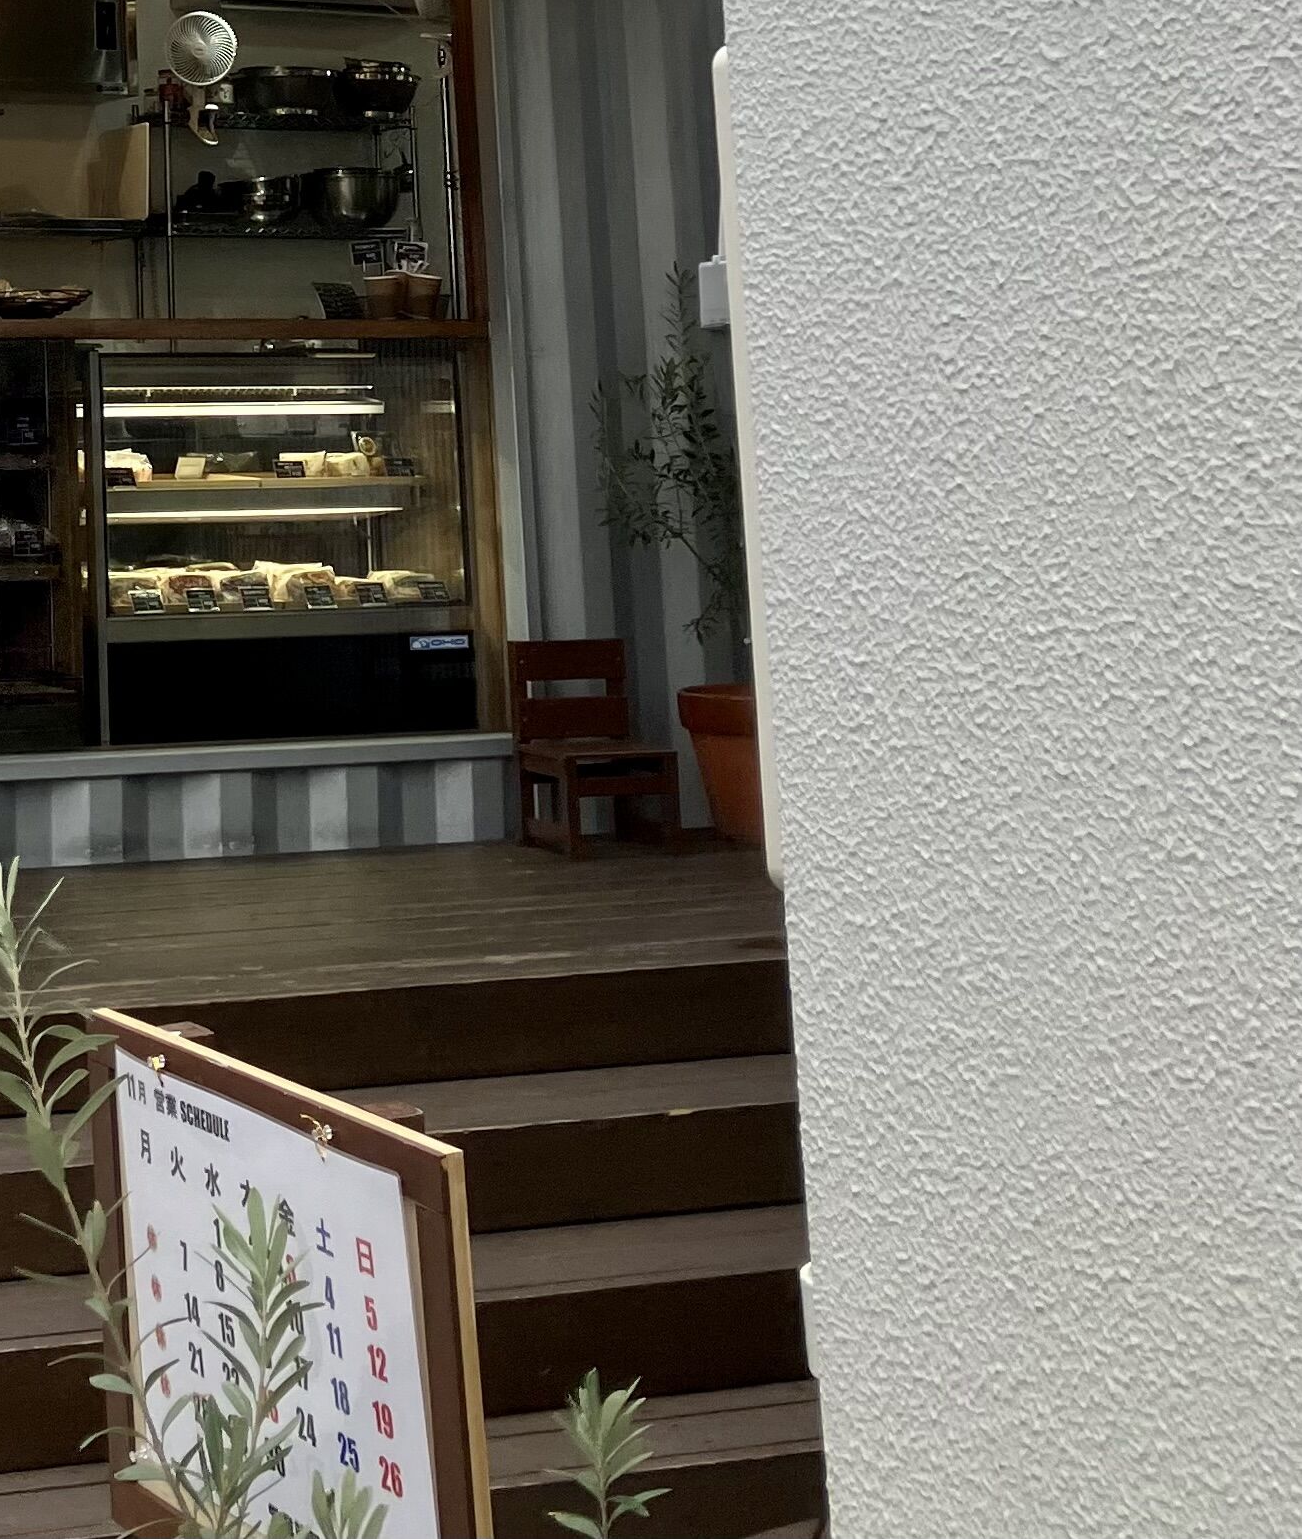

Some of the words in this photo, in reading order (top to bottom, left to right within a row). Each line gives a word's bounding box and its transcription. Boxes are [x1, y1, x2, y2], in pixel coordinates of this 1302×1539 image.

[180, 1100, 230, 1142] SCHEDULE
[140, 1128, 151, 1164] 月
[170, 1146, 186, 1182] 火
[204, 1163, 221, 1197] 水
[315, 1217, 334, 1258] 土
[355, 1237, 375, 1278] 日
[213, 1217, 221, 1249] 1
[324, 1275, 335, 1310] 4
[364, 1295, 378, 1331] 5
[180, 1239, 187, 1272] 7
[215, 1260, 225, 1293] 8
[326, 1322, 343, 1359] 11
[367, 1344, 388, 1383] 12
[183, 1292, 200, 1328] 14
[218, 1312, 236, 1348] 15
[330, 1377, 350, 1415] 18
[371, 1400, 394, 1440] 19
[188, 1341, 204, 1378] 21
[296, 1406, 316, 1448] 24
[337, 1431, 360, 1473] 25
[379, 1455, 403, 1498] 26
